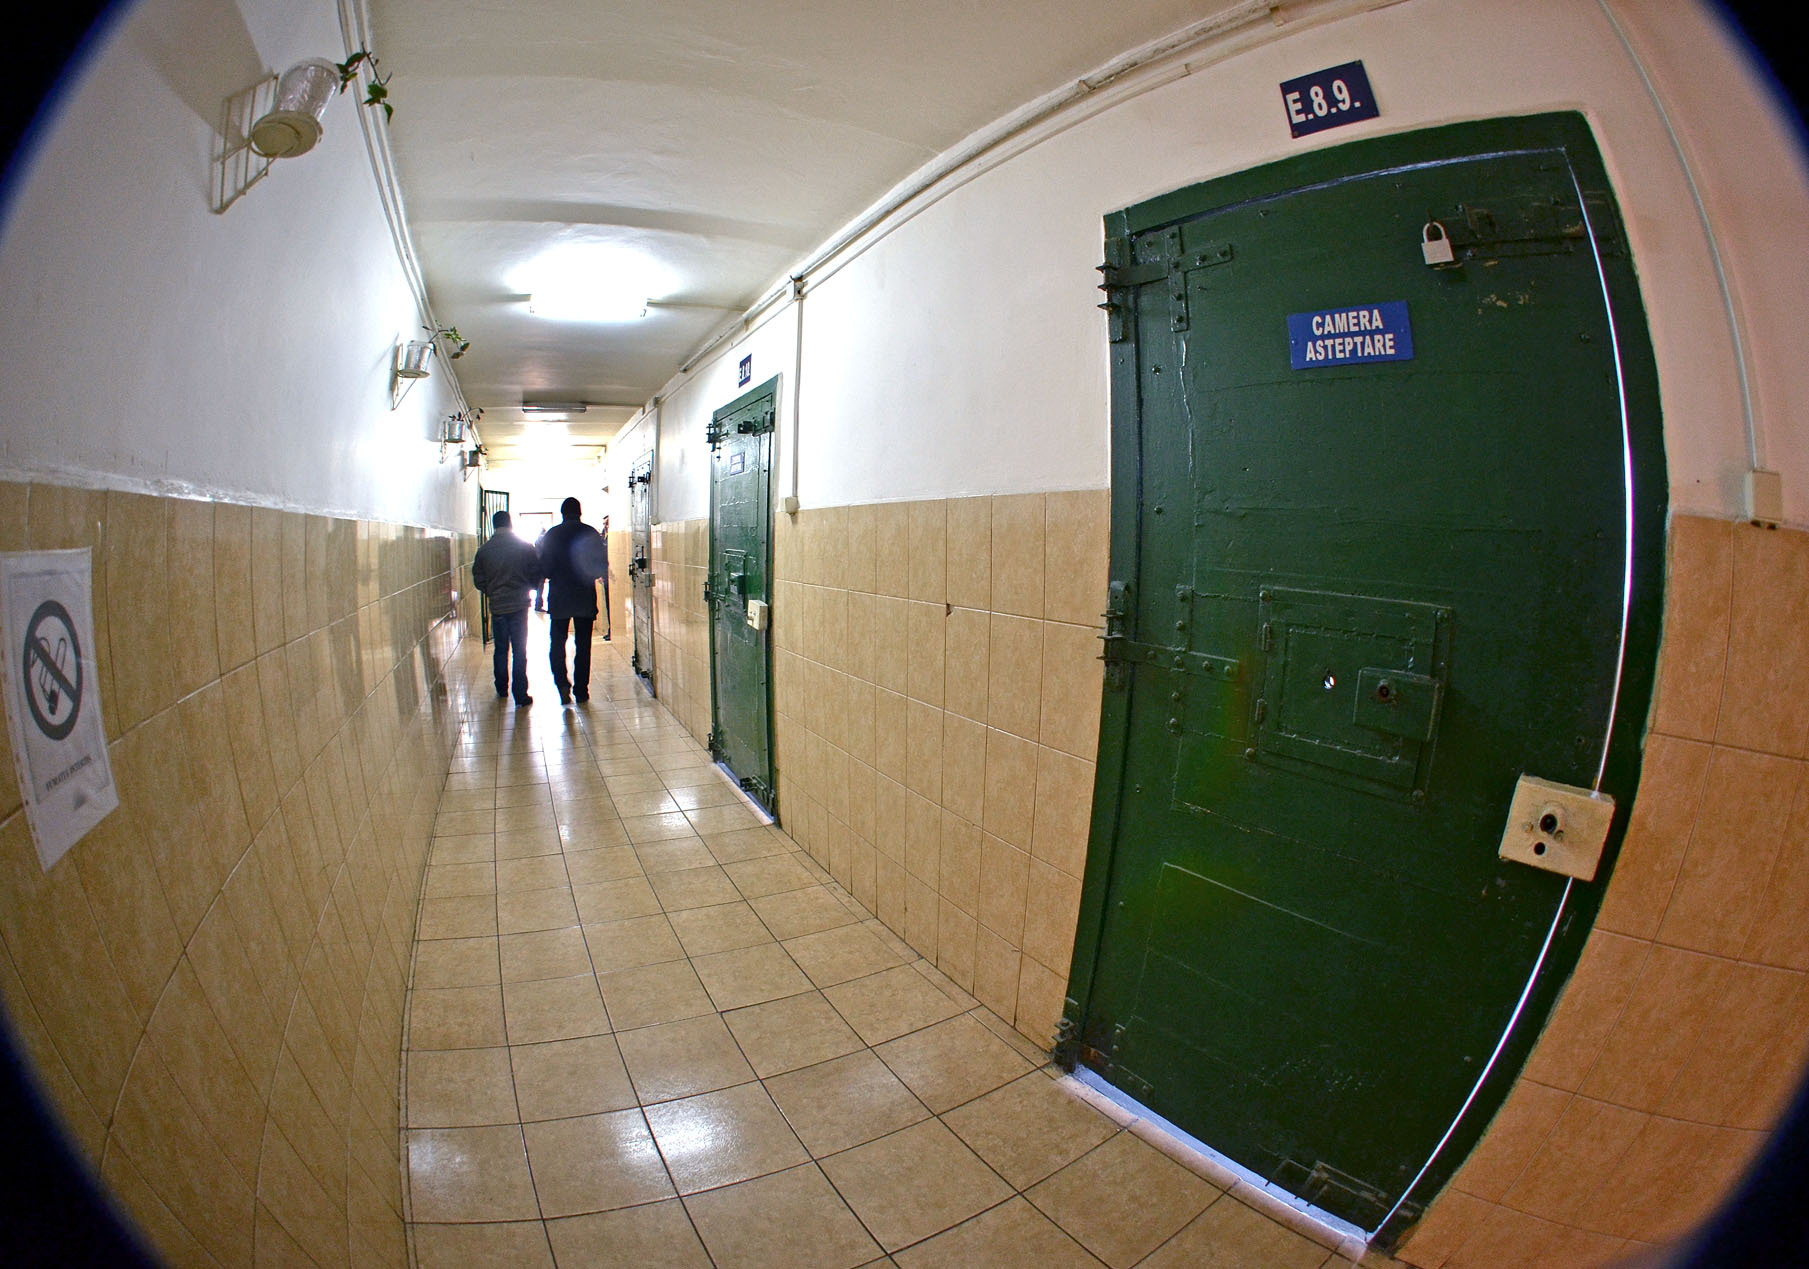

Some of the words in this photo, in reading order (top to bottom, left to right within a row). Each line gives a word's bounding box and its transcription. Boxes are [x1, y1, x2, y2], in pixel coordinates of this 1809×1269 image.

[1285, 79, 1361, 124] E.8.9.
[1312, 309, 1384, 336] CAMERA
[1305, 333, 1396, 361] ASTEPTARE
